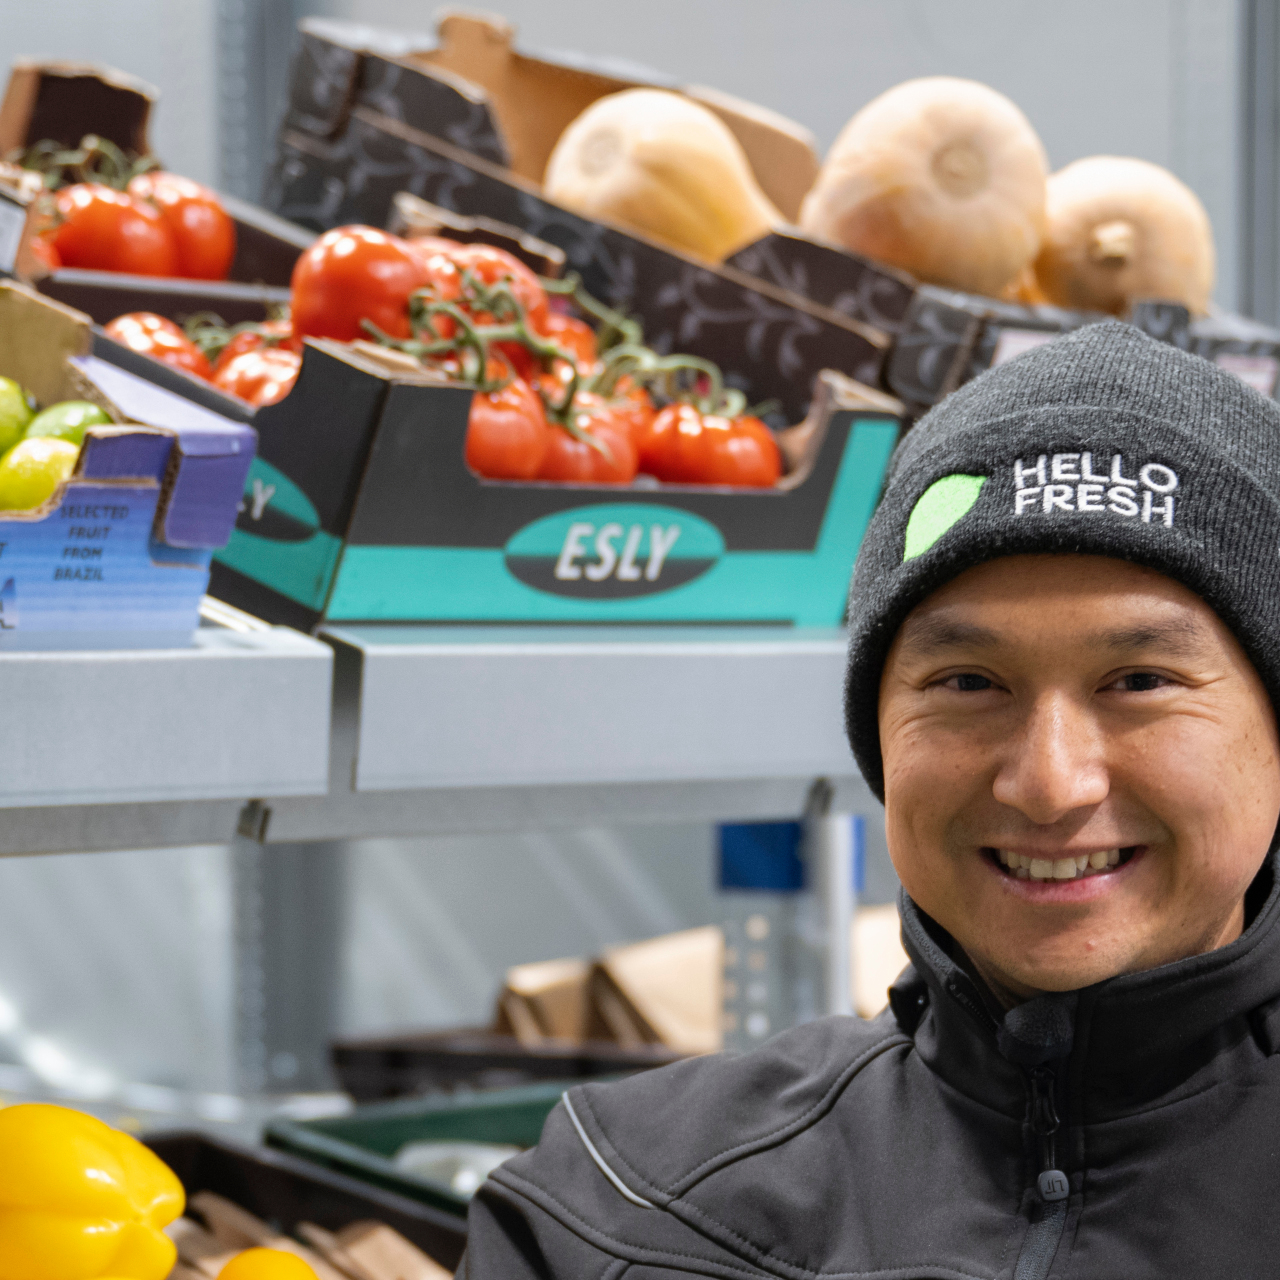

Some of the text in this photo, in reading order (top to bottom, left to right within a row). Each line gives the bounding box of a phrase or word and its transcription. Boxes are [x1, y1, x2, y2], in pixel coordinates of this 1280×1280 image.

[1014, 452, 1178, 493] HELLO
[60, 504, 128, 520] SELECTED
[1014, 484, 1174, 528] FRESH
[70, 526, 112, 540] FRUIT
[62, 547, 102, 560] FROM
[554, 522, 681, 581] ESLY
[54, 568, 104, 581] BRAZIL
